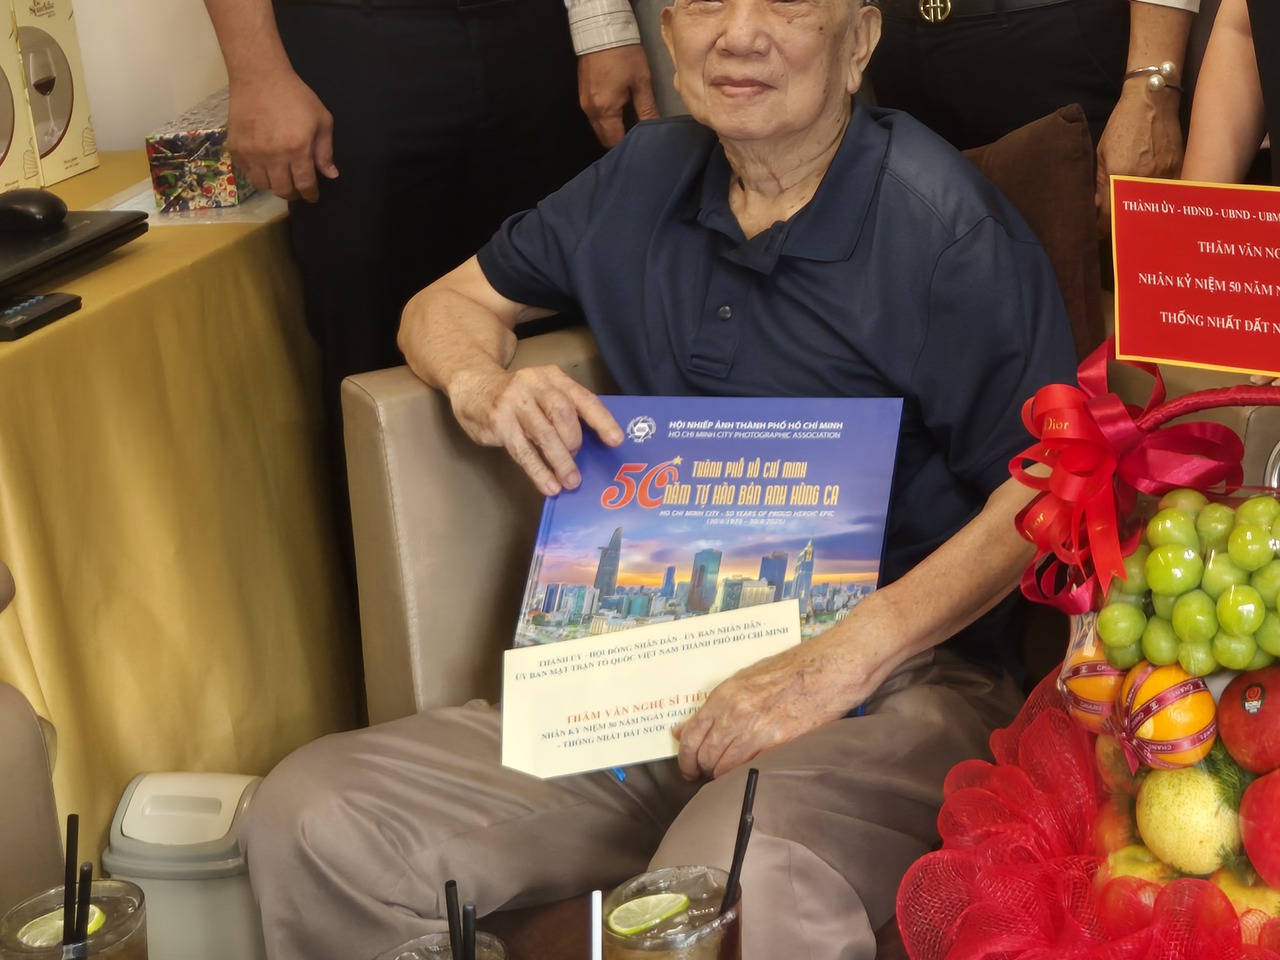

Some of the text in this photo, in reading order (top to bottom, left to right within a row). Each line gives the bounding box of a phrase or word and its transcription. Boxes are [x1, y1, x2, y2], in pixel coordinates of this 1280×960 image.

[1122, 199, 1159, 213] THÀNH
[1161, 200, 1175, 214] ỦY
[1183, 205, 1214, 217] HĐND
[1221, 208, 1251, 220] UBND
[1197, 240, 1235, 255] THĂM
[1238, 242, 1263, 257] VĂN
[1138, 271, 1174, 287] NHÂN
[1176, 273, 1192, 289] KỶ
[1195, 276, 1226, 293] NIỆM
[1229, 281, 1242, 293] 50
[1244, 280, 1273, 296] NĂM
[1160, 309, 1204, 327] THỐNG
[819, 421, 843, 430] MINH
[1045, 417, 1069, 430] Dior
[717, 431, 733, 439] CITY
[734, 431, 791, 439] PHOTOGRAPHIC
[792, 431, 841, 439] ASSOCIATION
[781, 461, 808, 479] MINH
[764, 484, 788, 506] ANH
[823, 484, 840, 506] CA
